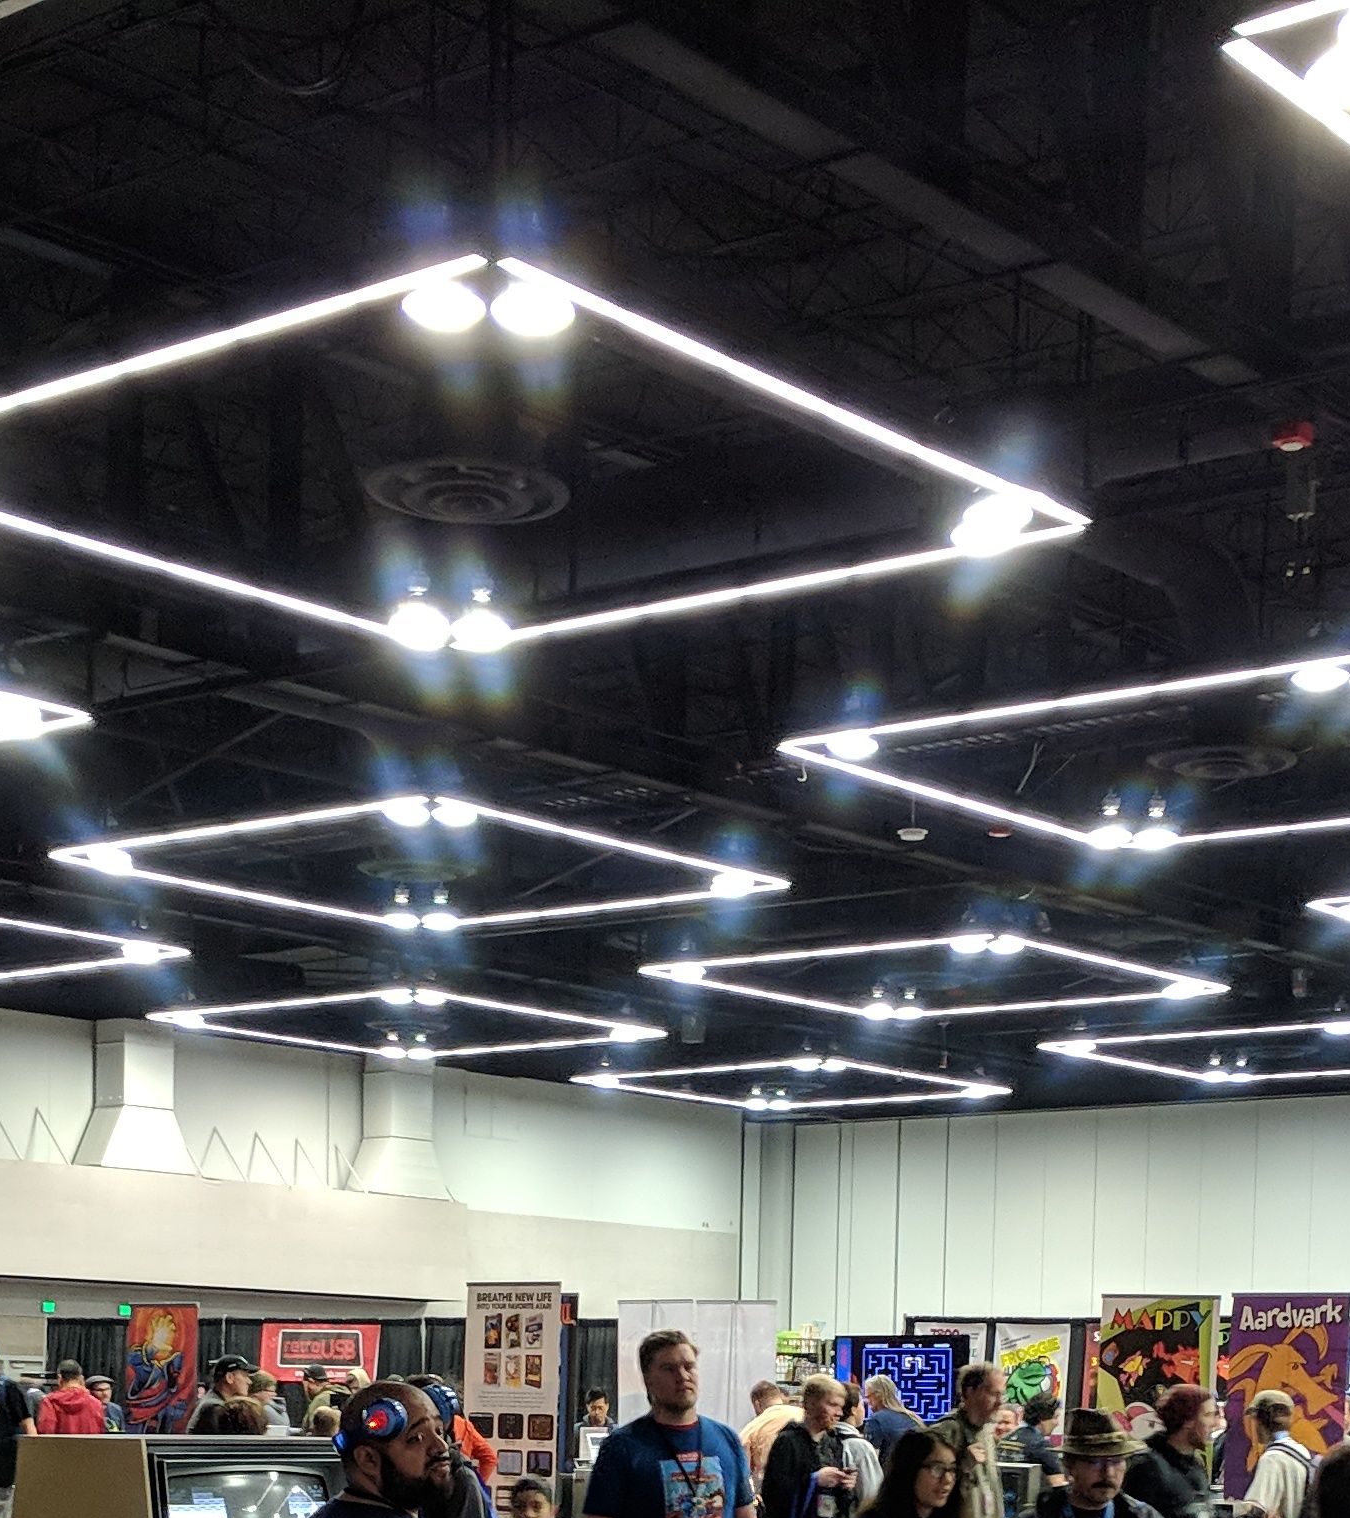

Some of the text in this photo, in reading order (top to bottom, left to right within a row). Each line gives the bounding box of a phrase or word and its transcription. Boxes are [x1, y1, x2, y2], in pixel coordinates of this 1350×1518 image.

[476, 1292, 552, 1302] BREATHE NEW LIFE
[1110, 1308, 1211, 1331] MAPPY
[1238, 1298, 1343, 1332] Aardvark
